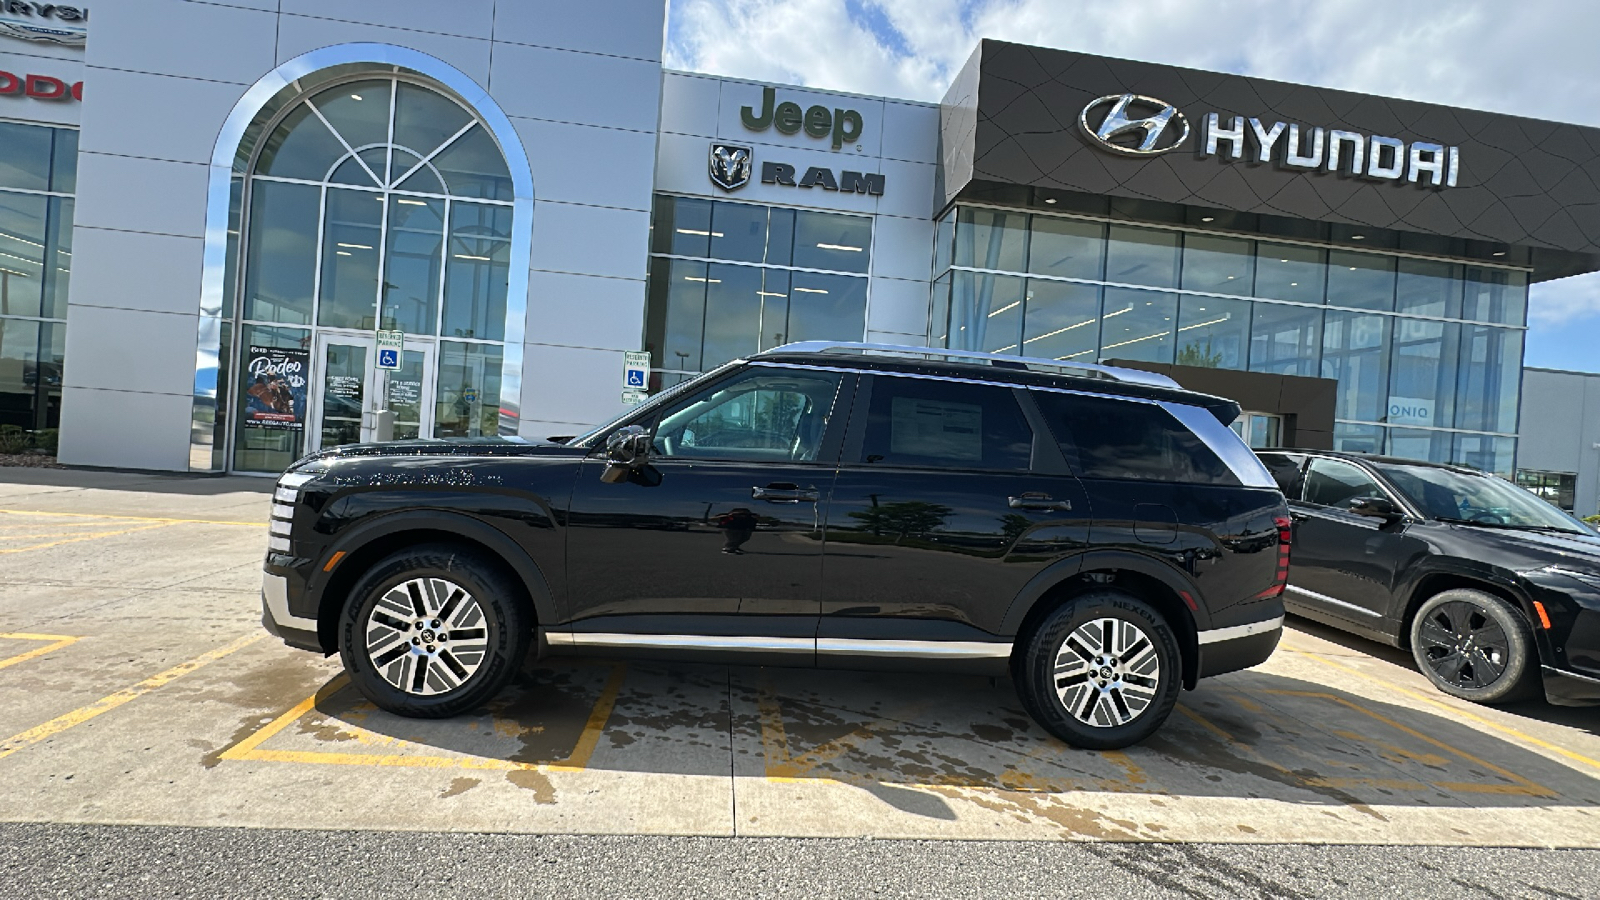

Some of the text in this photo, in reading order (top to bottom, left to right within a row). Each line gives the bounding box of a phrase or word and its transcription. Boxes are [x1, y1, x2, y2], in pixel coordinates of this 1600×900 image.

[741, 86, 863, 151] Jeep
[1205, 111, 1460, 188] HYUNDAI
[761, 161, 886, 196] RAM
[248, 356, 302, 379] Rodeo
[1112, 600, 1156, 625] NEXEN
